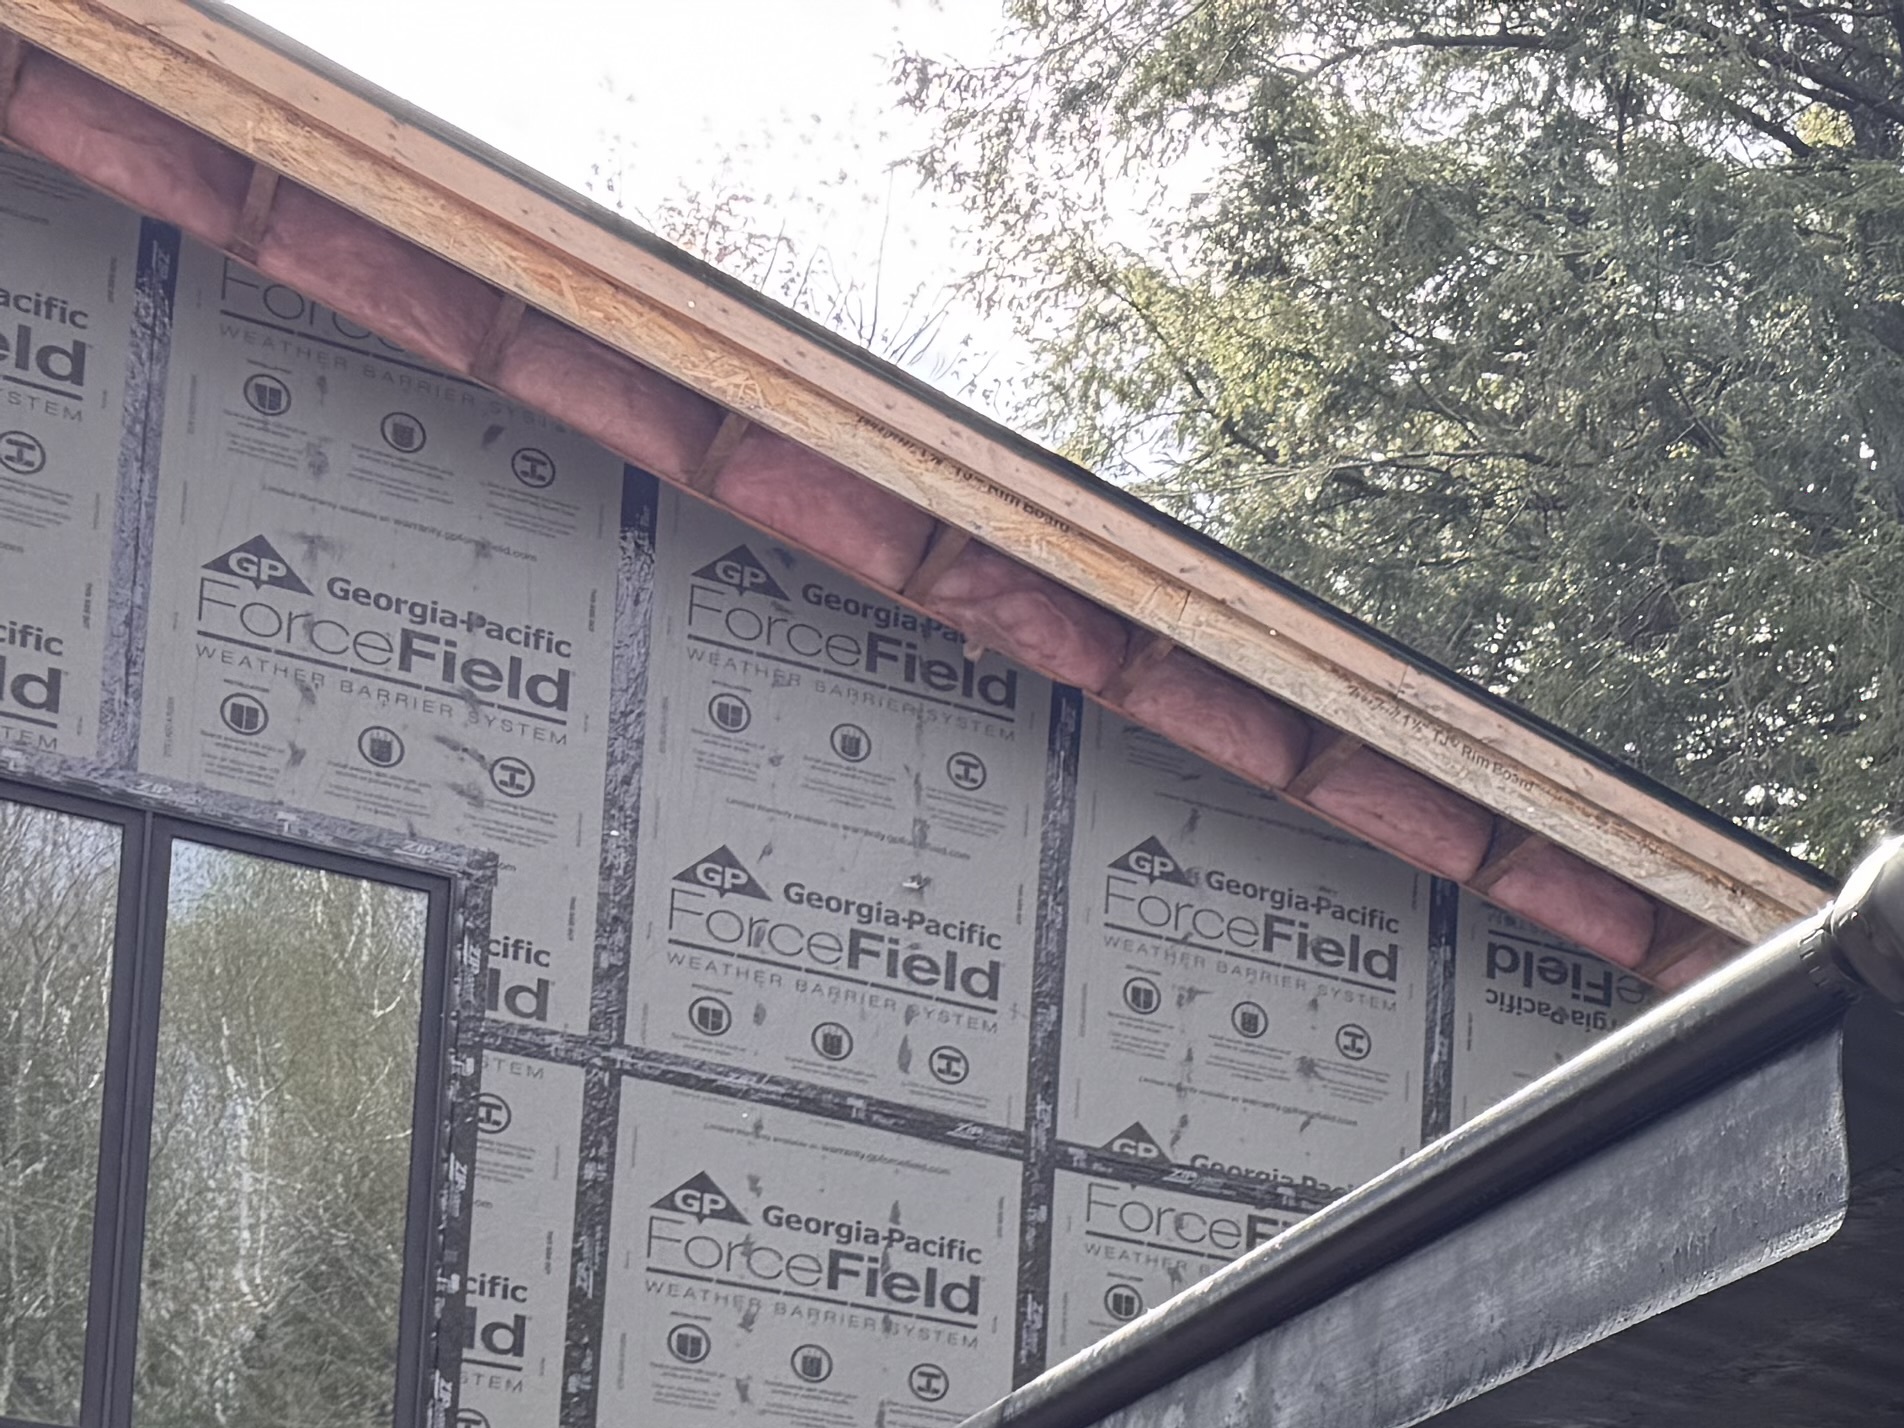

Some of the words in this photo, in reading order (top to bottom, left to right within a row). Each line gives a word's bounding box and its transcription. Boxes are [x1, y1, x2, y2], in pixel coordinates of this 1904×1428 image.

[220, 323, 347, 369] WEATHER
[228, 552, 287, 581] GP
[715, 561, 766, 586] GP
[198, 577, 571, 712] ForceField
[327, 576, 572, 658] Georgia-Pacific
[690, 584, 1017, 711] ForceField
[196, 644, 326, 686] WEATHER
[341, 680, 453, 718] BARRIER
[468, 709, 567, 746] SYSTEM
[687, 647, 801, 687] WEATHER
[815, 679, 918, 718] BARRIER
[928, 708, 1015, 741] SYSTEM
[1462, 744, 1488, 769] Rim
[696, 863, 748, 888] GP
[1128, 851, 1174, 876] GP
[783, 882, 1001, 950] Georgia-Pacific
[1105, 875, 1398, 982] ForceField
[1206, 870, 1398, 933] Georgia-Pacific
[669, 888, 1000, 1001] ForceField
[1104, 935, 1205, 968] WEATHER
[1217, 960, 1306, 991] BARRIER
[1317, 984, 1397, 1012] SYSTEM
[667, 952, 782, 987] WEATHER
[796, 977, 896, 1013] BARRIER
[905, 1004, 998, 1033] SYSTEM
[674, 1190, 727, 1214] GP
[763, 1205, 982, 1264] Georgia-Pacific
[647, 1216, 980, 1316] ForceField
[1085, 1243, 1187, 1270] WEATHER
[646, 1280, 761, 1310] WEATHER
[775, 1301, 876, 1330] BARRIER
[893, 1320, 978, 1349] SYSTEM
